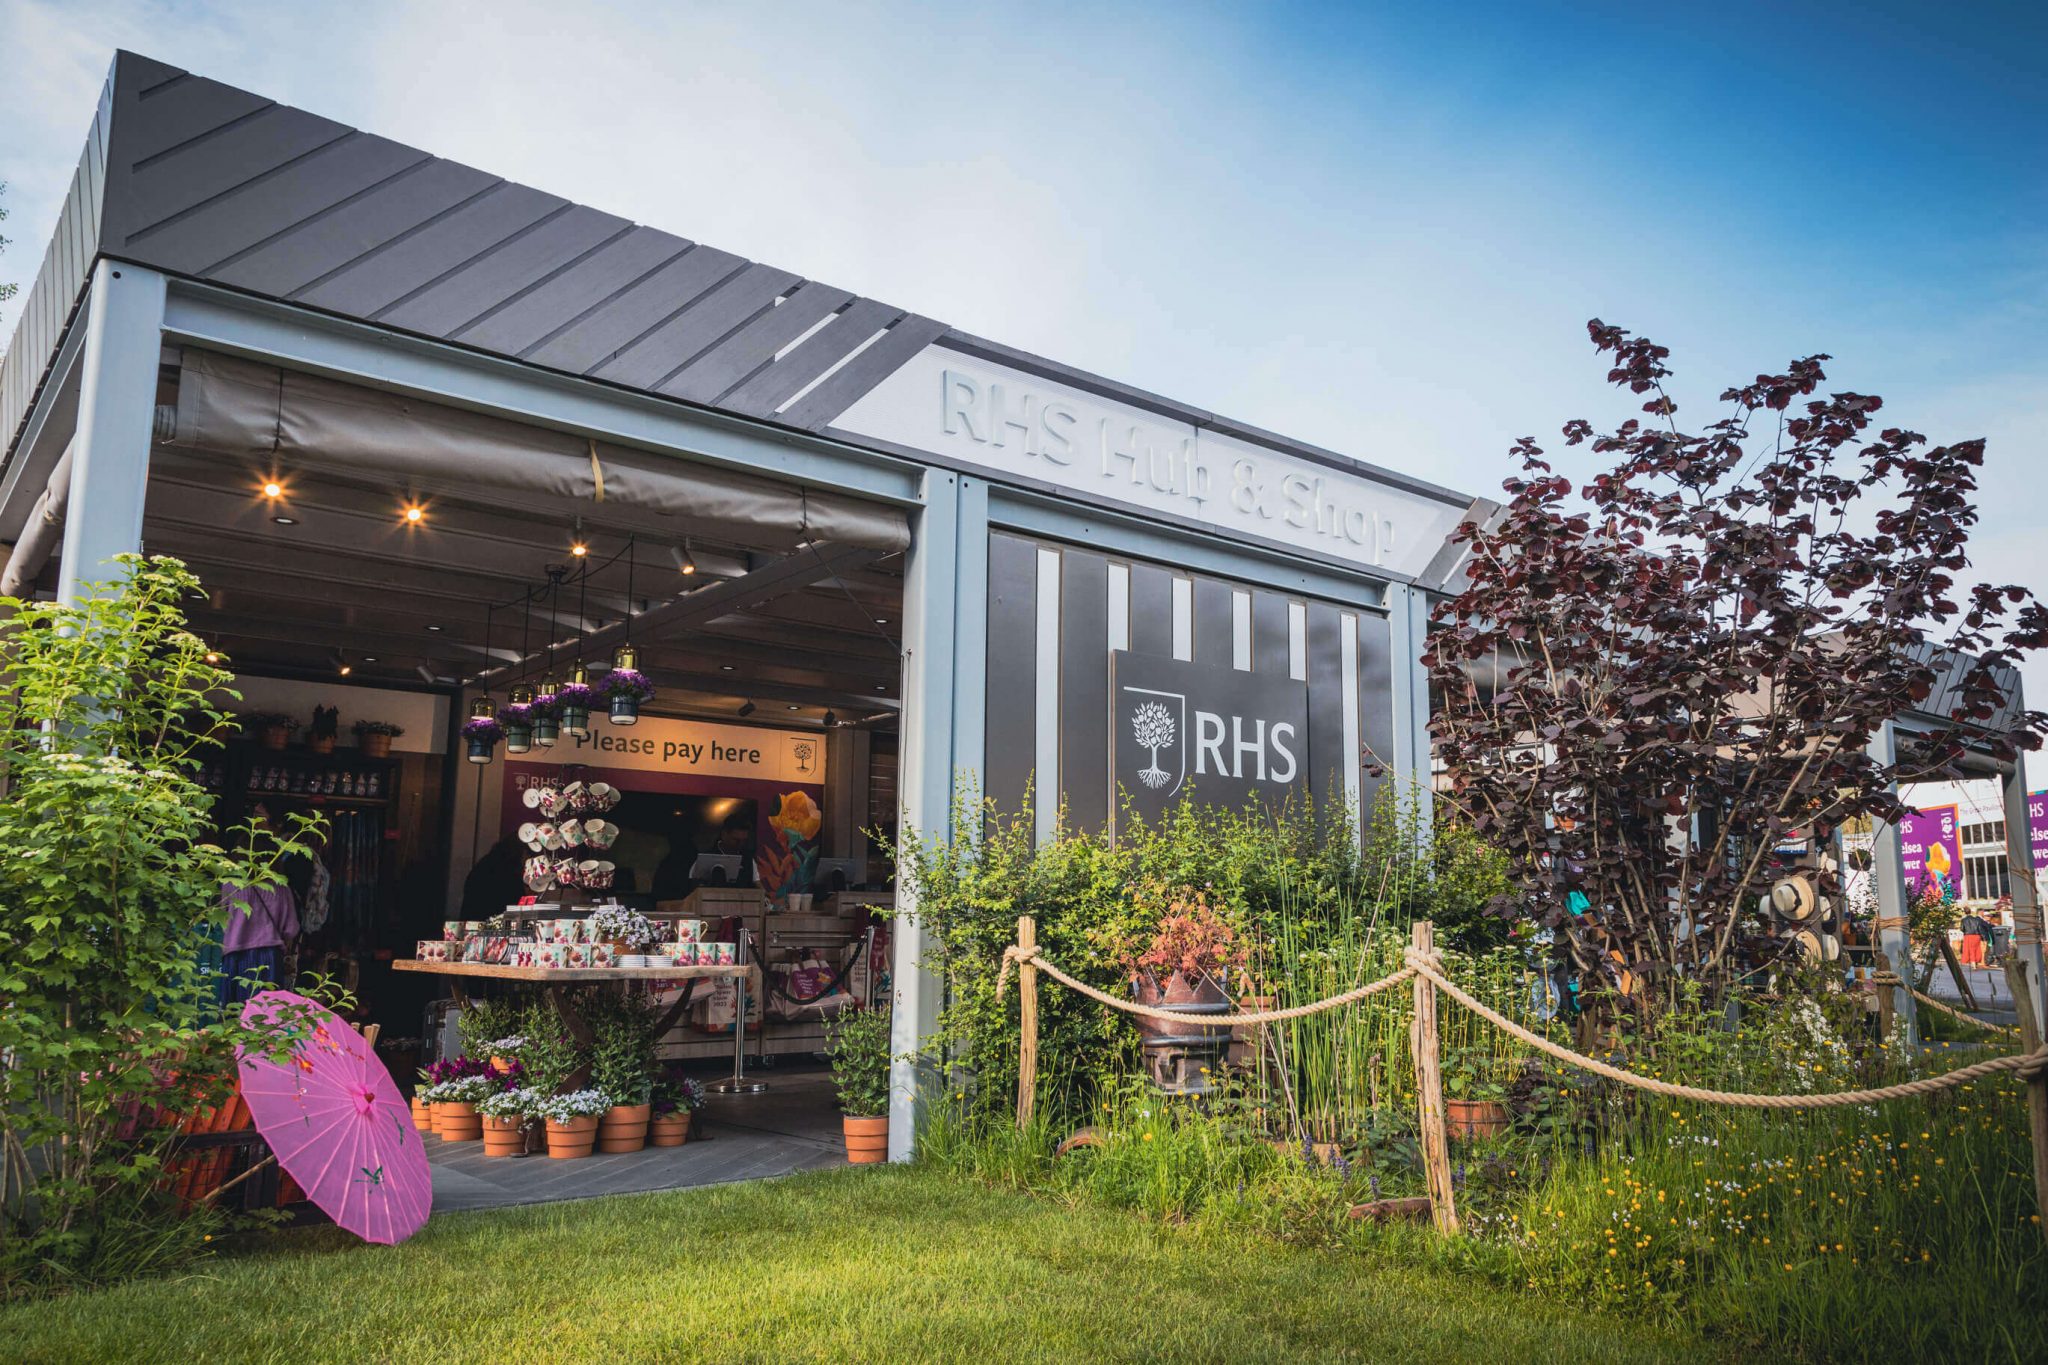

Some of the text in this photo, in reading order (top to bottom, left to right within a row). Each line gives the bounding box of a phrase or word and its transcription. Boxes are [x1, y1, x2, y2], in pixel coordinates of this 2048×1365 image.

[942, 370, 1395, 566] RHS Hub & Shop
[576, 729, 760, 764] Please pay here
[1195, 711, 1297, 784] RHS
[2028, 802, 2044, 818] HS
[1903, 859, 1921, 870] wer
